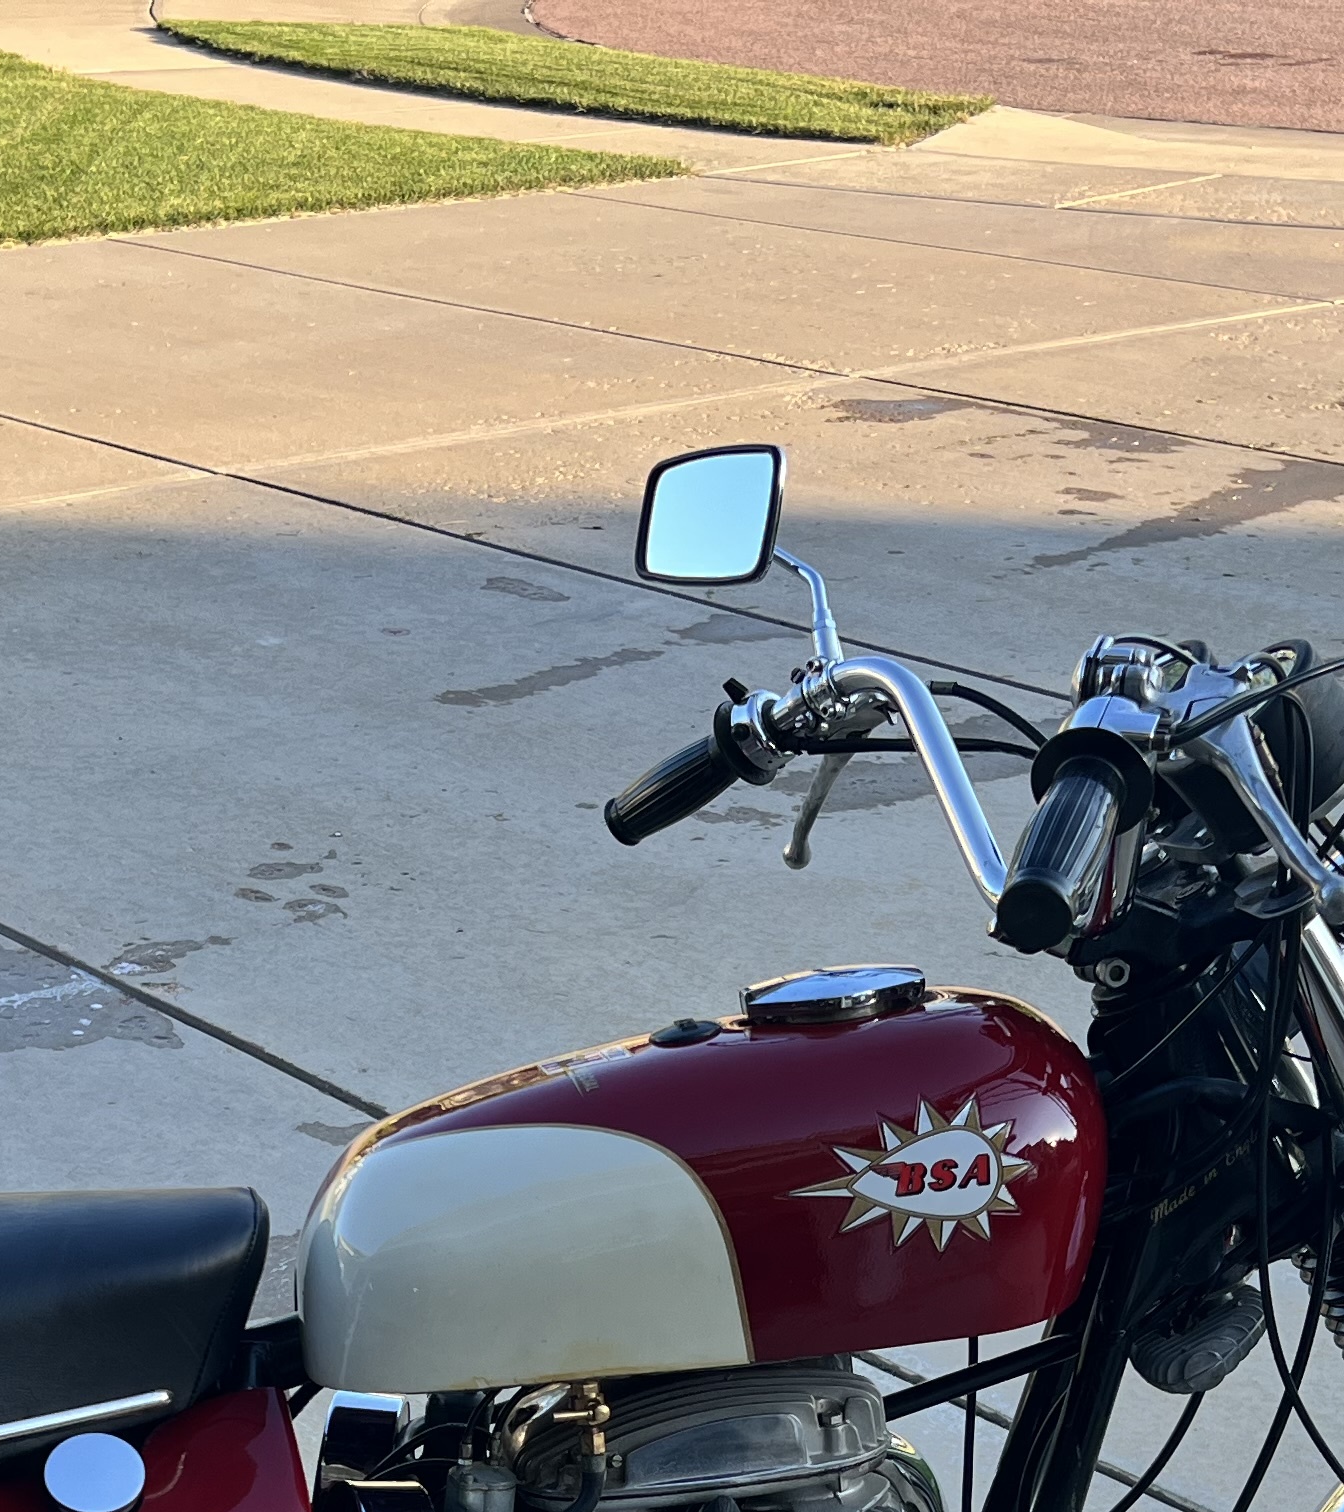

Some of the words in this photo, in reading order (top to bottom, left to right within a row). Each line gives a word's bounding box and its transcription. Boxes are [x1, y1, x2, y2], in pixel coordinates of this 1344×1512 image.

[895, 1154, 990, 1197] BSA
[1150, 1186, 1195, 1224] Made
[1203, 1167, 1218, 1185] in
